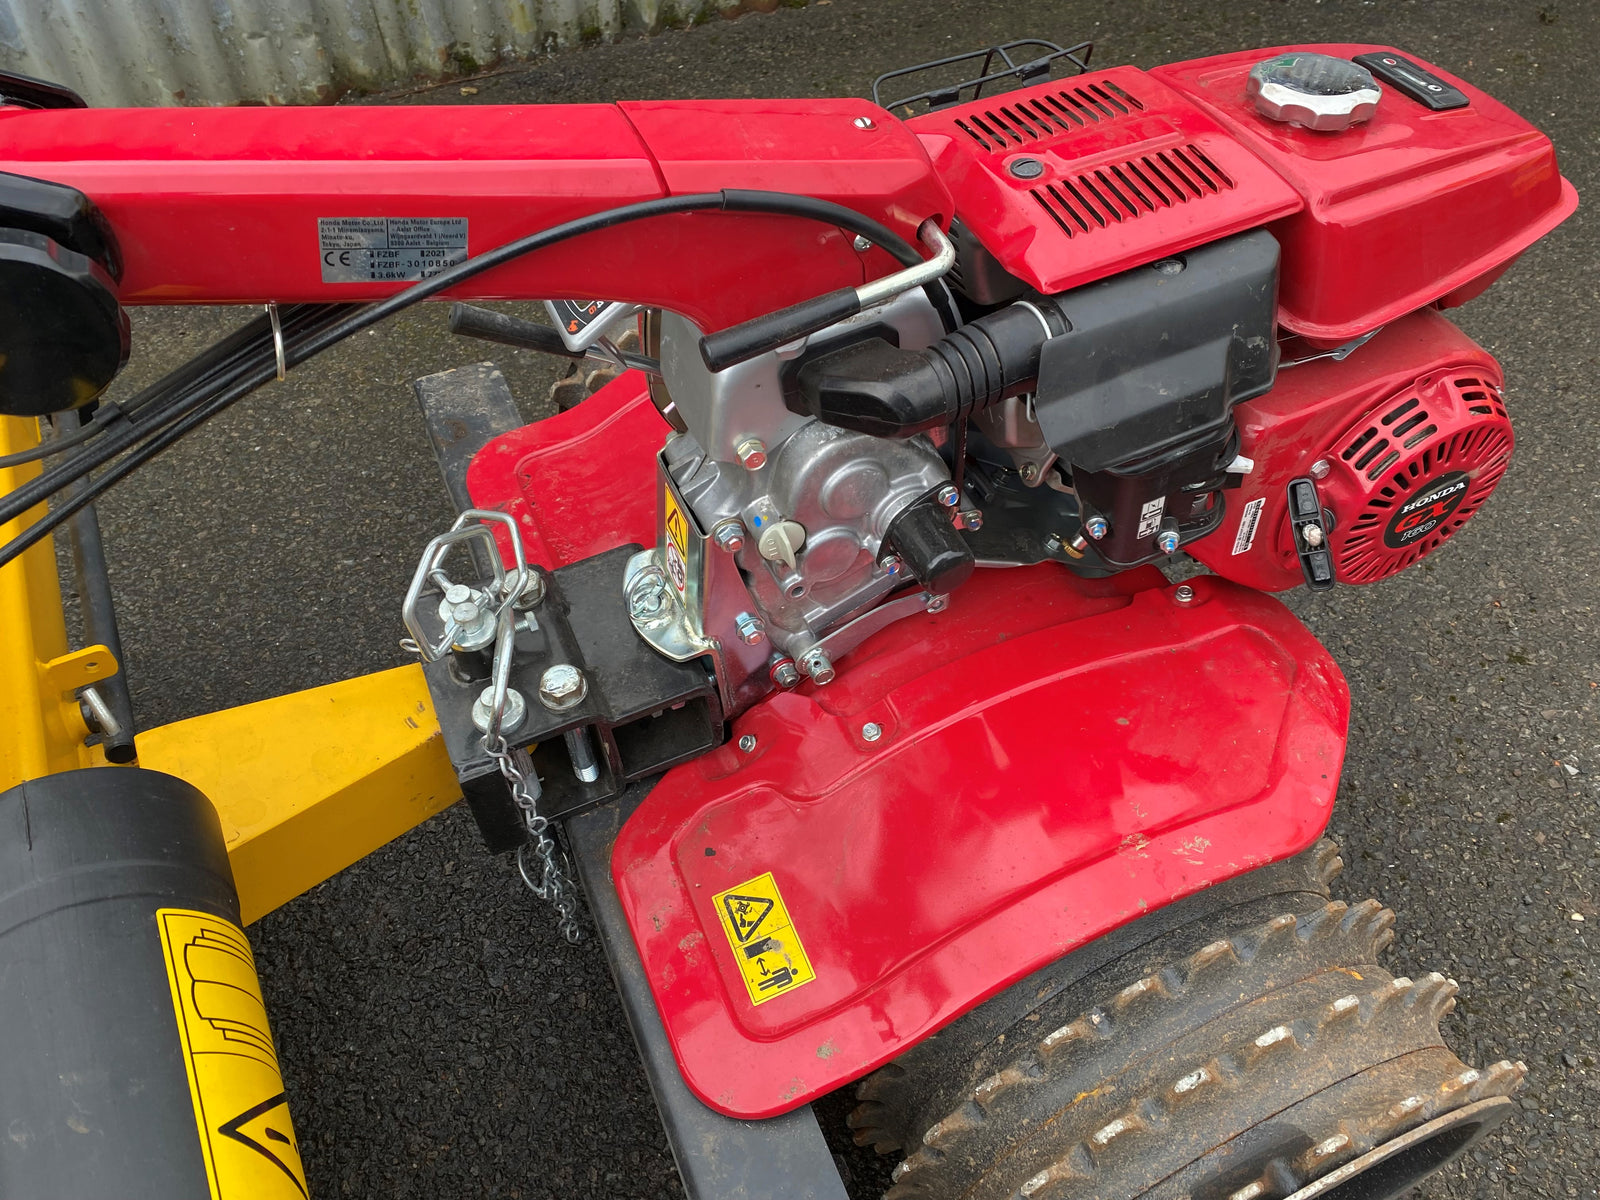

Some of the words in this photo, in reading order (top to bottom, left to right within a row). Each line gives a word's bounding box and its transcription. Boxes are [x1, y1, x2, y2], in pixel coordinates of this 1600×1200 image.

[1401, 482, 1466, 514] HONDA
[1394, 494, 1458, 533] GX
[1401, 520, 1436, 541] 160
[767, 538, 778, 559] OIL
